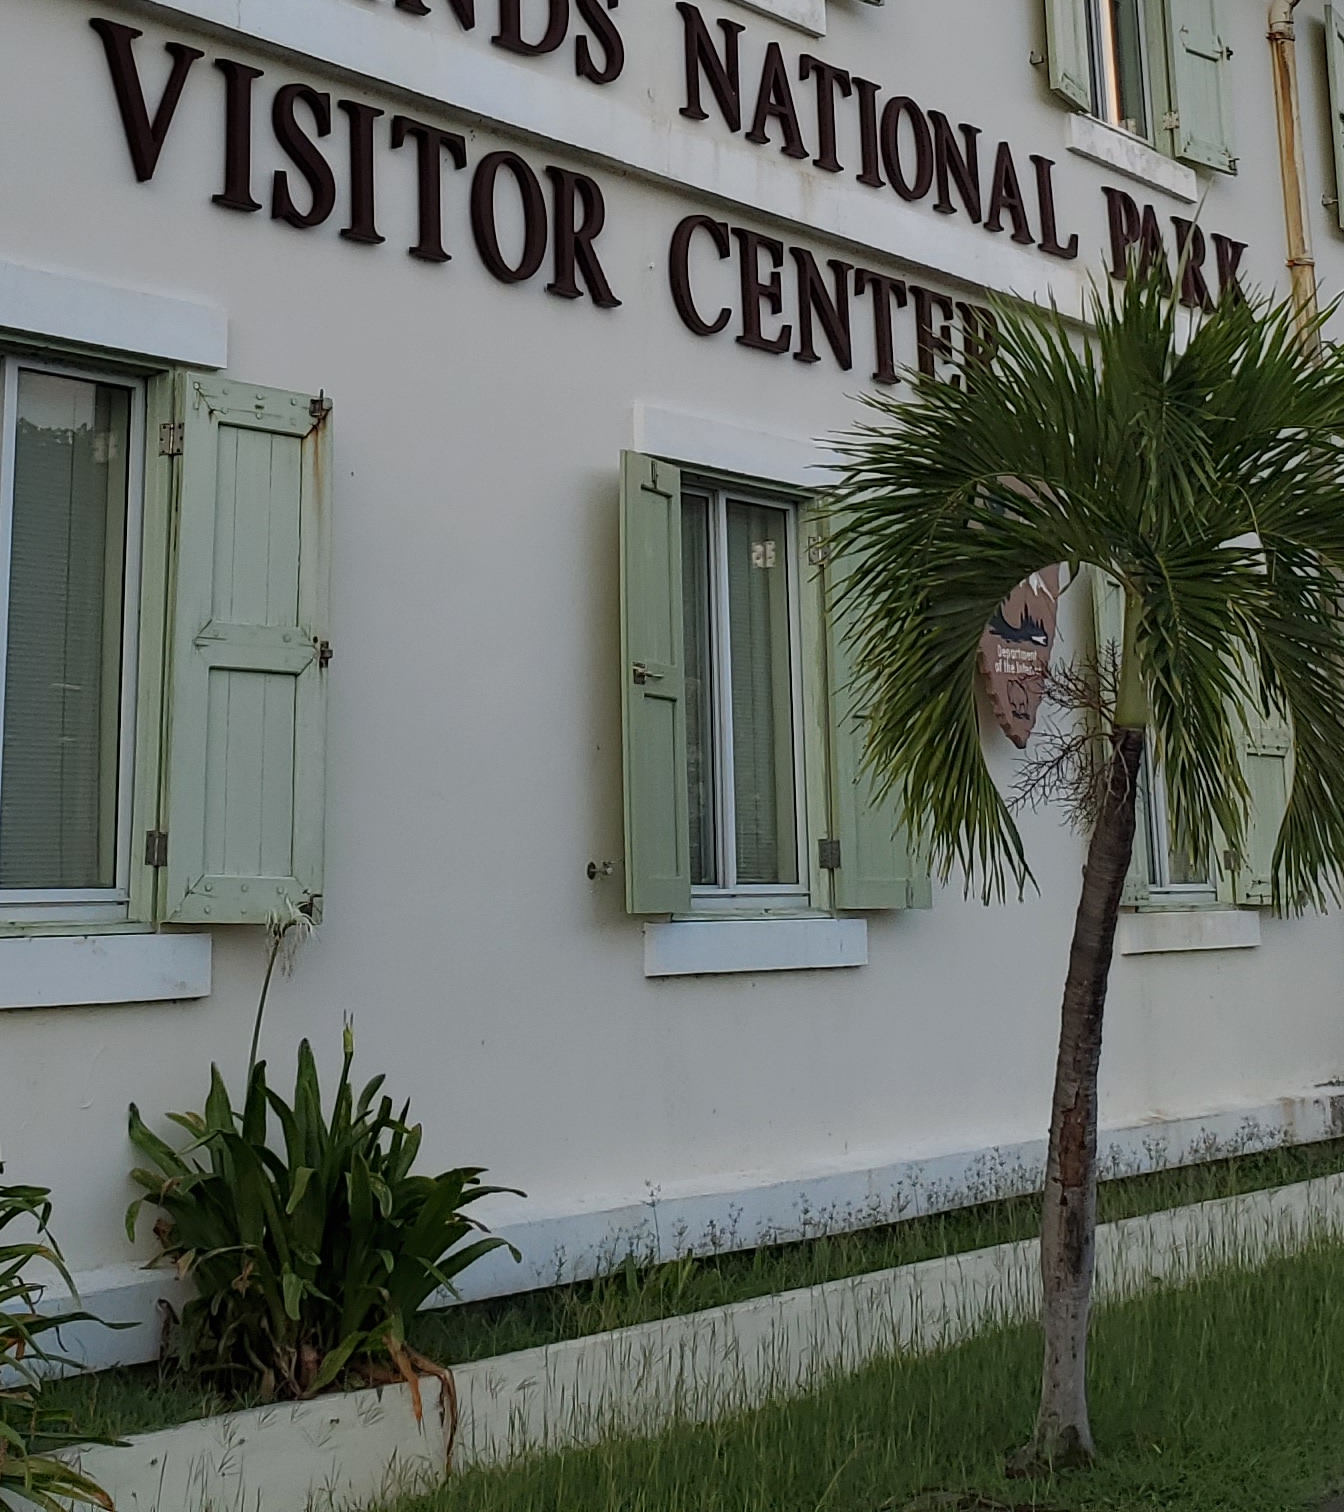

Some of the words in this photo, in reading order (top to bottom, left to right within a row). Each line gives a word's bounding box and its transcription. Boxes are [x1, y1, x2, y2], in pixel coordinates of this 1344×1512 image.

[90, 17, 622, 308] VISITOR
[676, 1, 1079, 259] NATIONAL
[1100, 186, 1251, 316] PARK
[995, 658, 1002, 673] of
[1003, 658, 1016, 674] the
[997, 644, 1037, 661] Department
